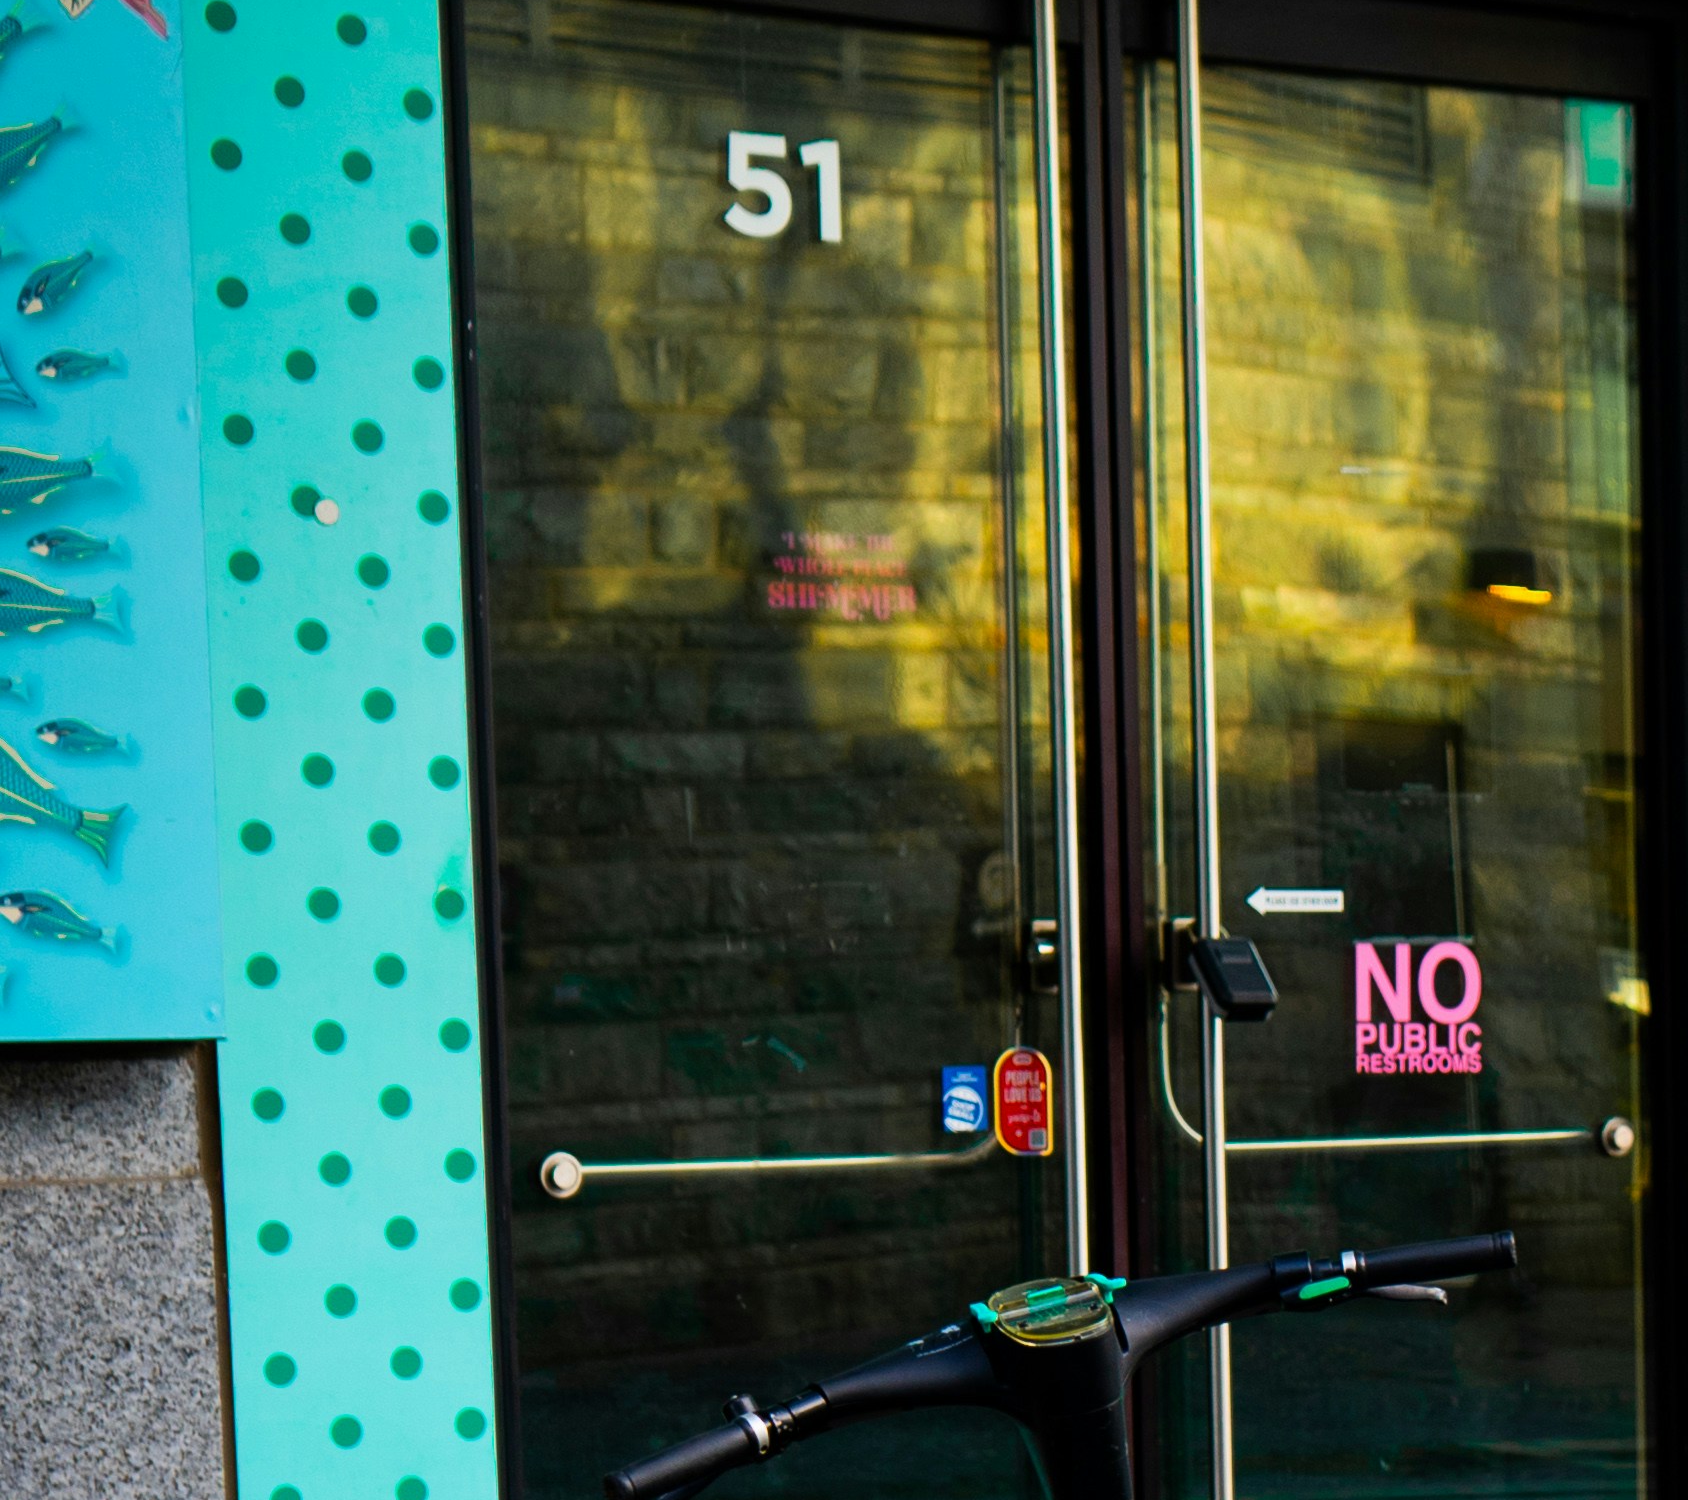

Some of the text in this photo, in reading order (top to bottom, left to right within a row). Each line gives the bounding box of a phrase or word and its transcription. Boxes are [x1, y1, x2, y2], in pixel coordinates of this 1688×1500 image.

[724, 130, 843, 243] 51
[1355, 941, 1482, 1025] NO
[1356, 1022, 1482, 1056] PUBLIC
[1356, 1053, 1482, 1074] RESTROOMS
